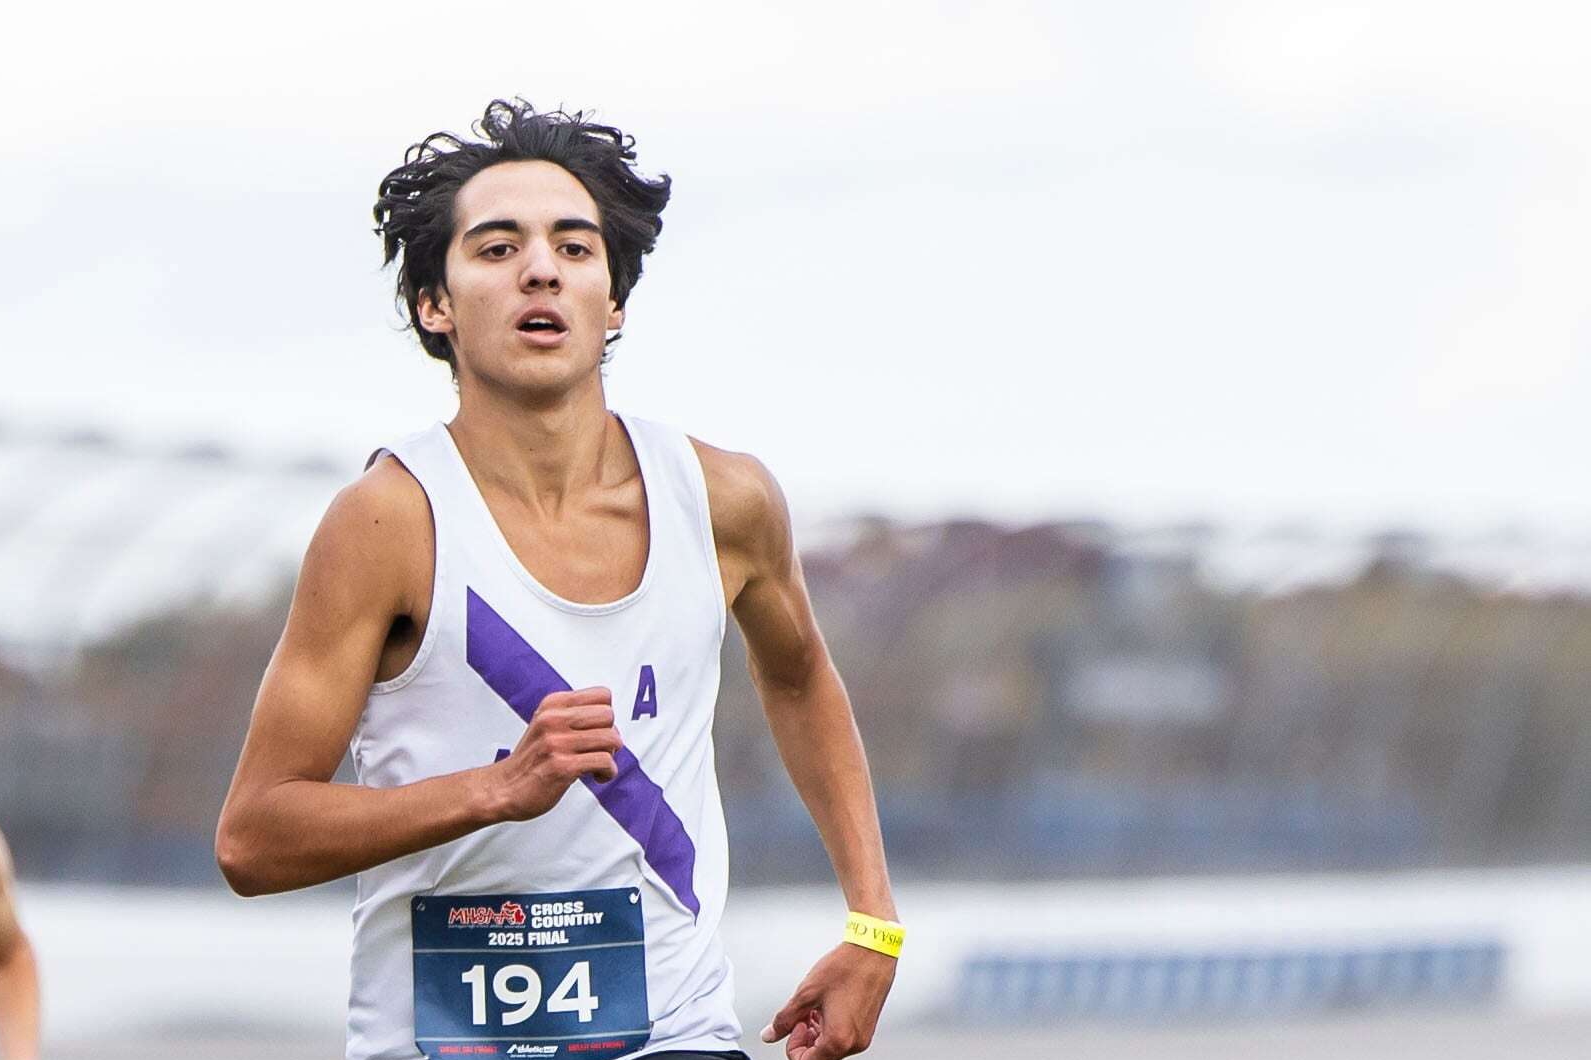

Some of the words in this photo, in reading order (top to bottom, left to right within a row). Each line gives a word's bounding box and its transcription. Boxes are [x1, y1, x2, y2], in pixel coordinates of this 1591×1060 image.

[631, 665, 658, 721] A
[530, 901, 584, 916] CROSS
[531, 912, 604, 929] COUNTRY
[488, 932, 524, 946] 2025
[527, 930, 569, 946] FINAL
[461, 961, 599, 1026] 194
